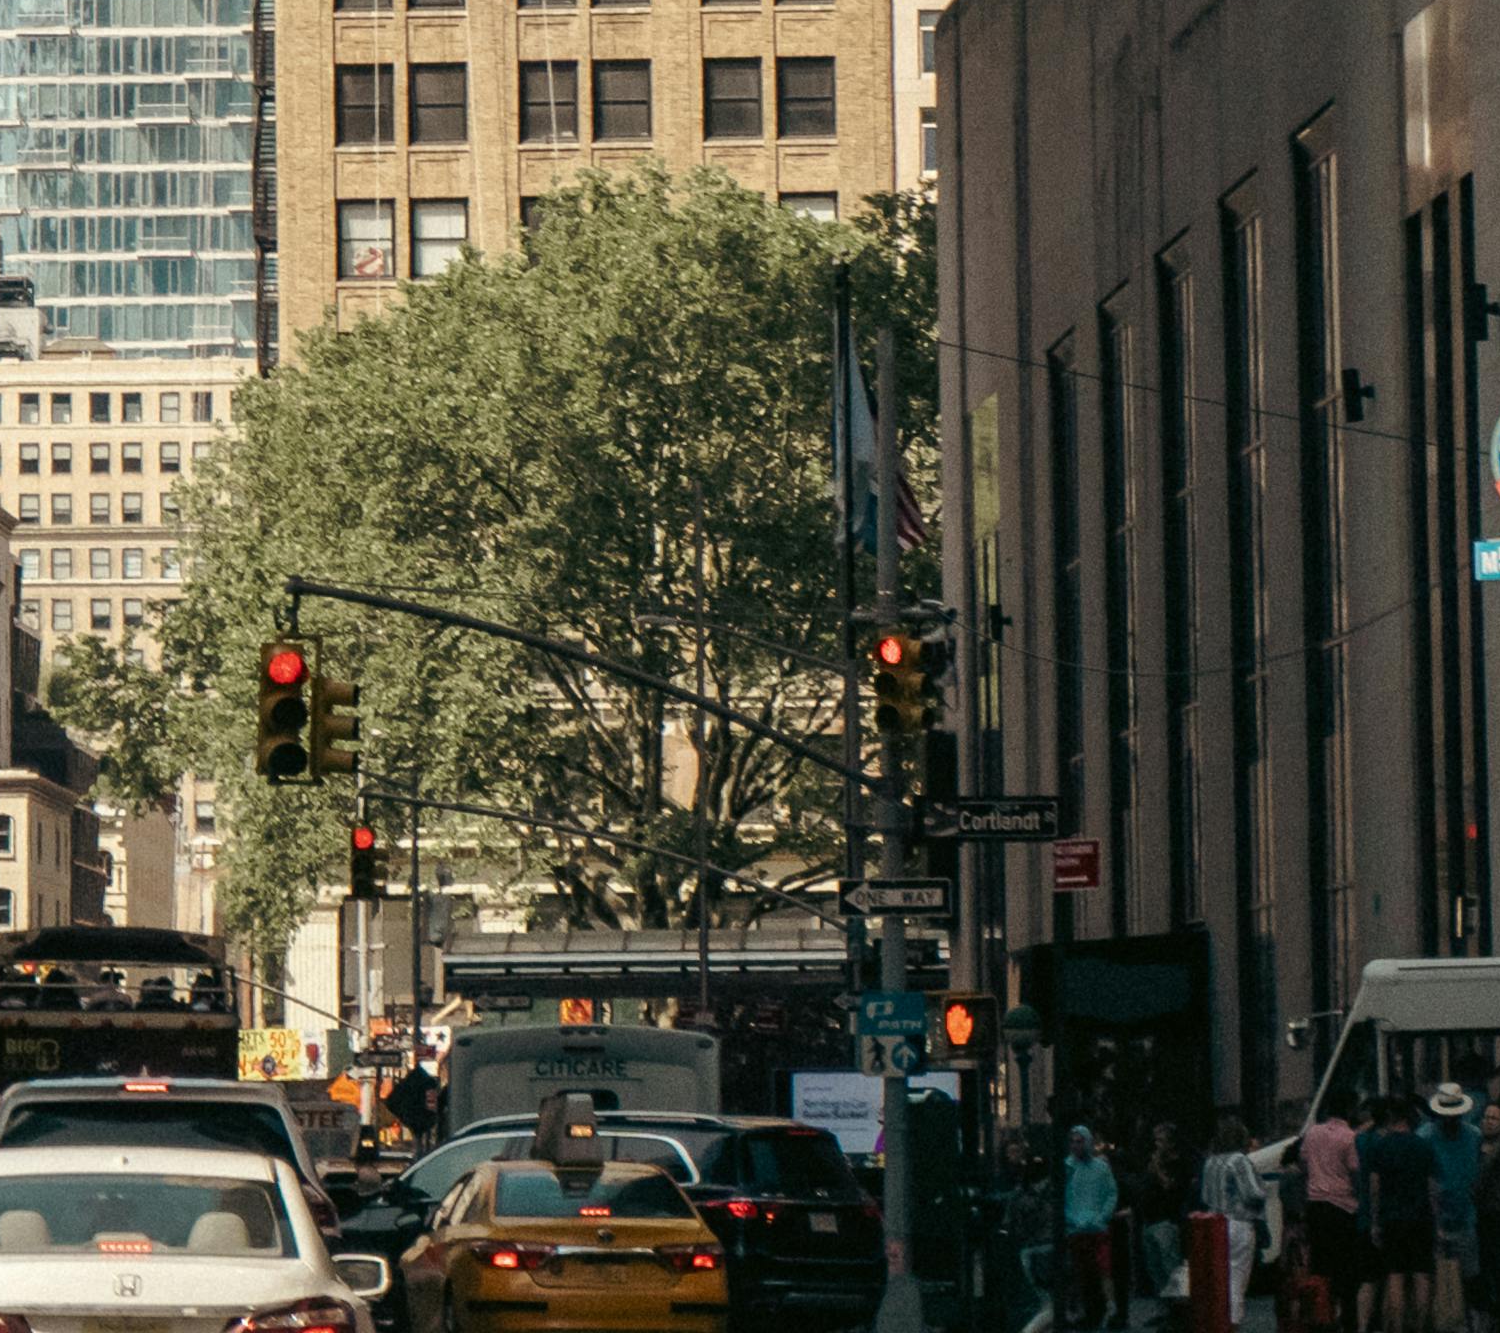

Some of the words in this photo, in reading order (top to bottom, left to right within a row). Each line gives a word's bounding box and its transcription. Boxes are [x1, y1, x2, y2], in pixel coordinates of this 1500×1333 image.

[958, 811, 1042, 831] Cortlandt
[854, 888, 887, 906] ONE
[901, 888, 937, 905] WAY
[535, 1059, 628, 1077] CITICARE
